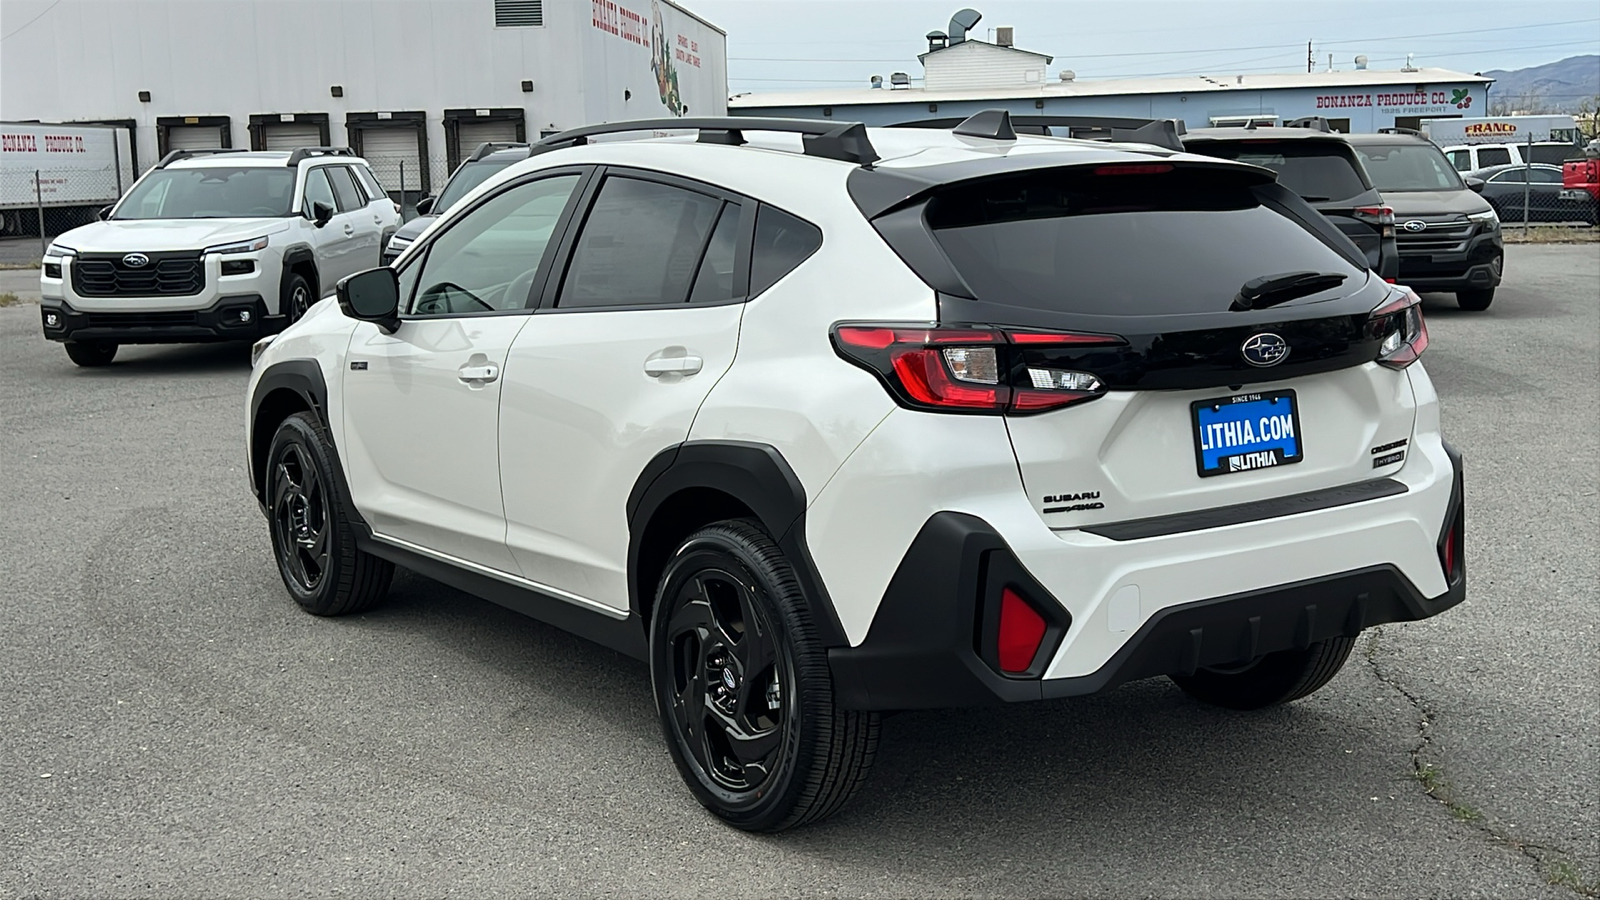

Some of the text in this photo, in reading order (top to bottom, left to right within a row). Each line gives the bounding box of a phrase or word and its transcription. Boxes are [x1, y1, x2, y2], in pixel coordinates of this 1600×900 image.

[1316, 92, 1449, 109] BONANZA PRODUCE CO.
[1402, 106, 1447, 114] FREEPORT
[1464, 122, 1517, 133] FRANCO
[2, 134, 37, 152] BONANZA
[44, 135, 73, 153] PRODUCE
[1231, 395, 1248, 404] SINCE
[1199, 413, 1295, 451] LITHIA.COM
[1240, 450, 1278, 471] LITHIA
[1043, 491, 1100, 503] SUBARU
